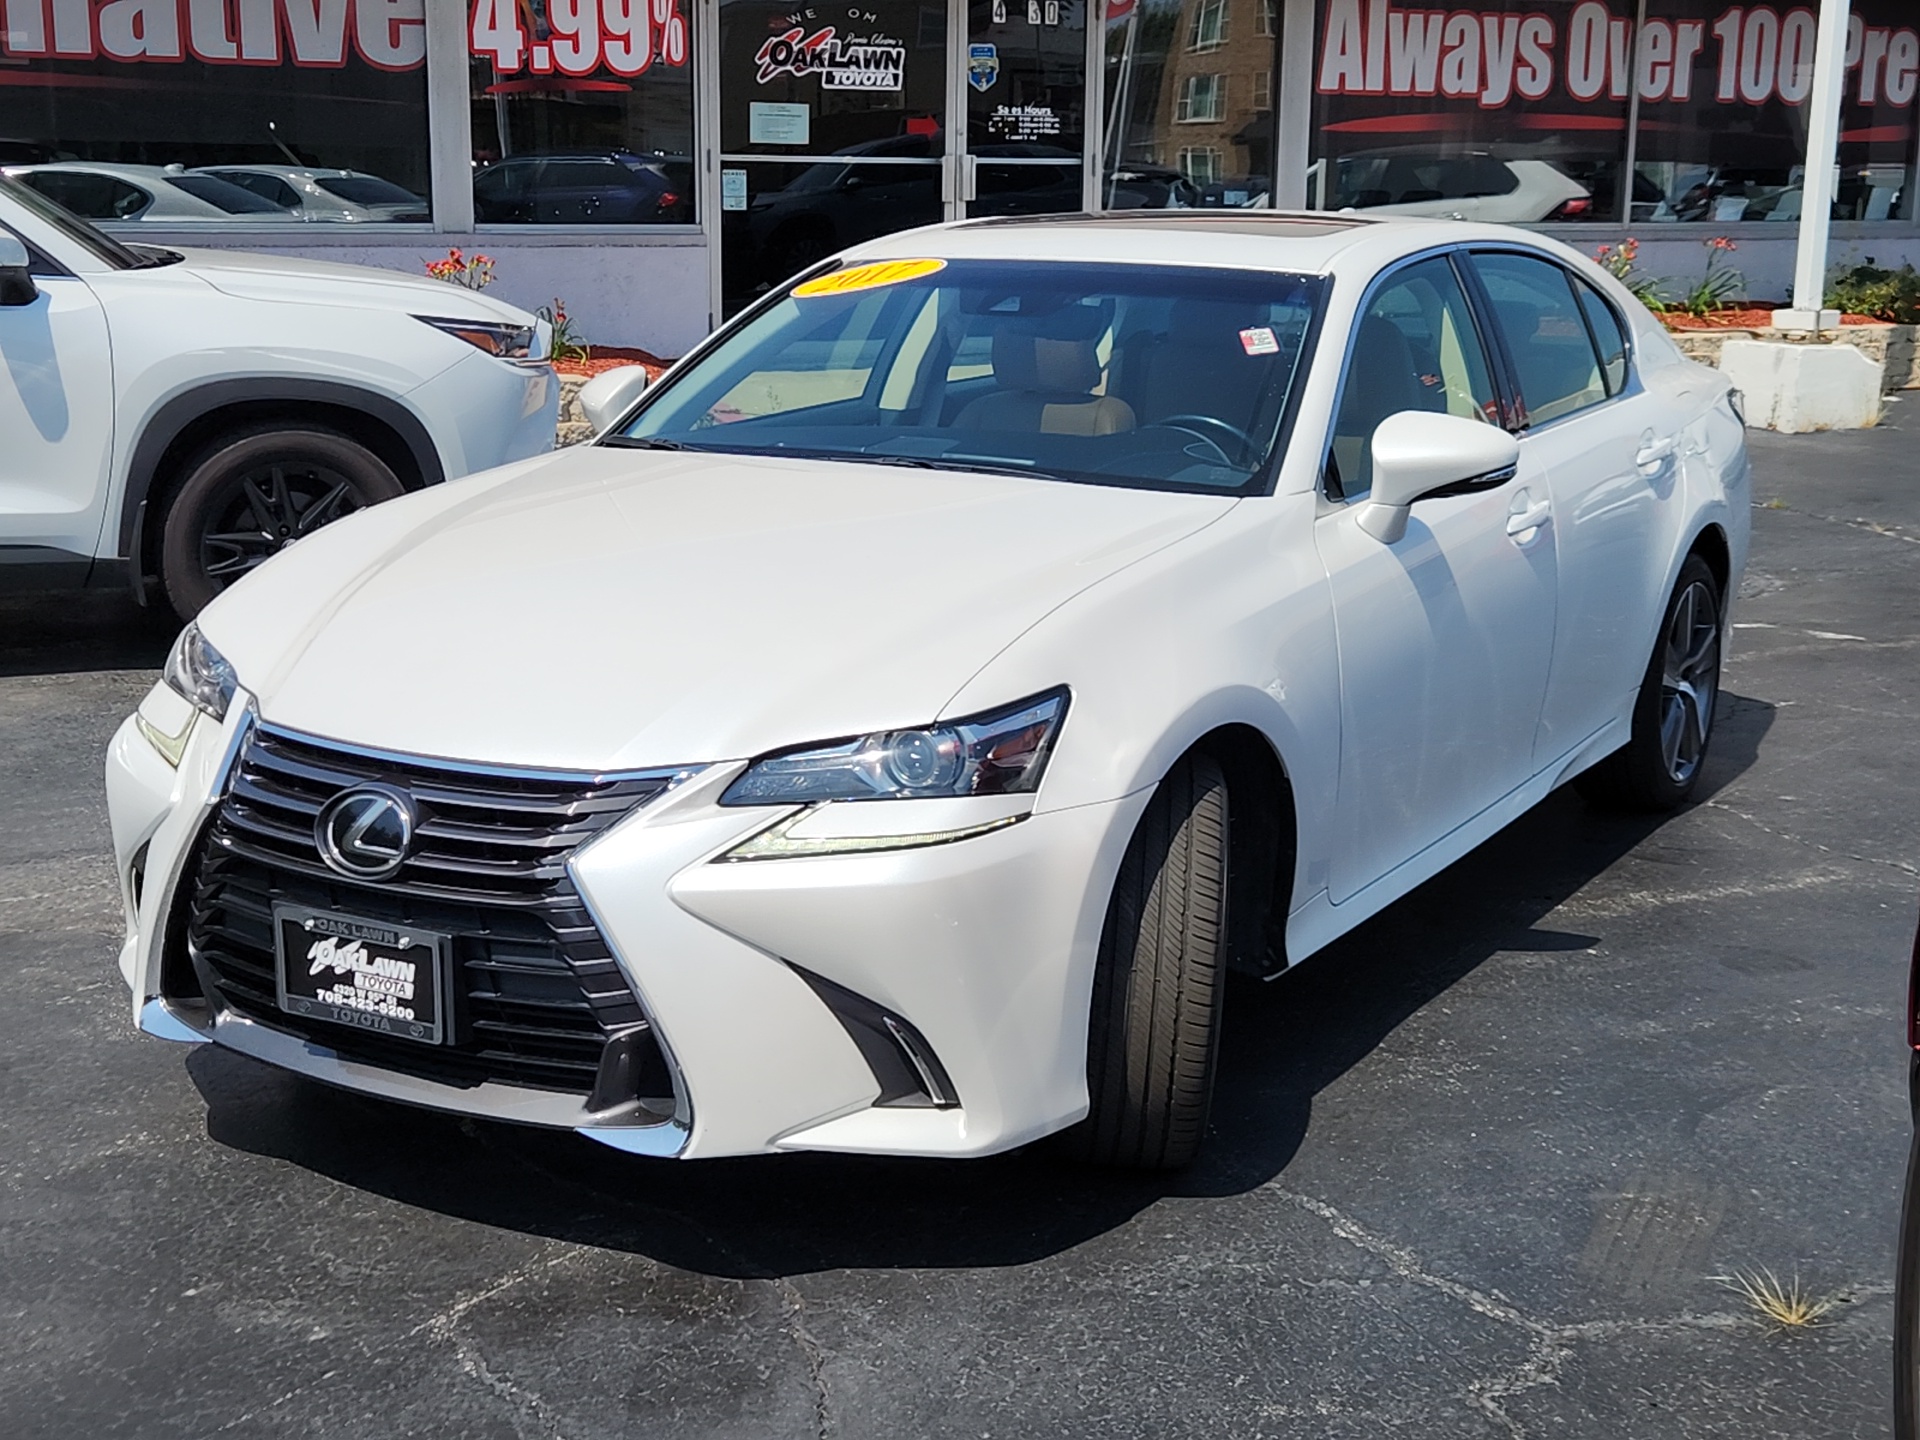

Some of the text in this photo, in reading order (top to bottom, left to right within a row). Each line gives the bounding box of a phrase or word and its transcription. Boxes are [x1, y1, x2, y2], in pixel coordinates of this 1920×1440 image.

[1317, 0, 1555, 107] Always
[1567, 1, 1703, 101] Over
[1713, 5, 1815, 106] 100
[831, 71, 895, 87] TOYOTA
[317, 918, 396, 943] OAK LAWN
[361, 974, 406, 996] TOYOTA
[331, 1007, 392, 1031] TOYOTA
